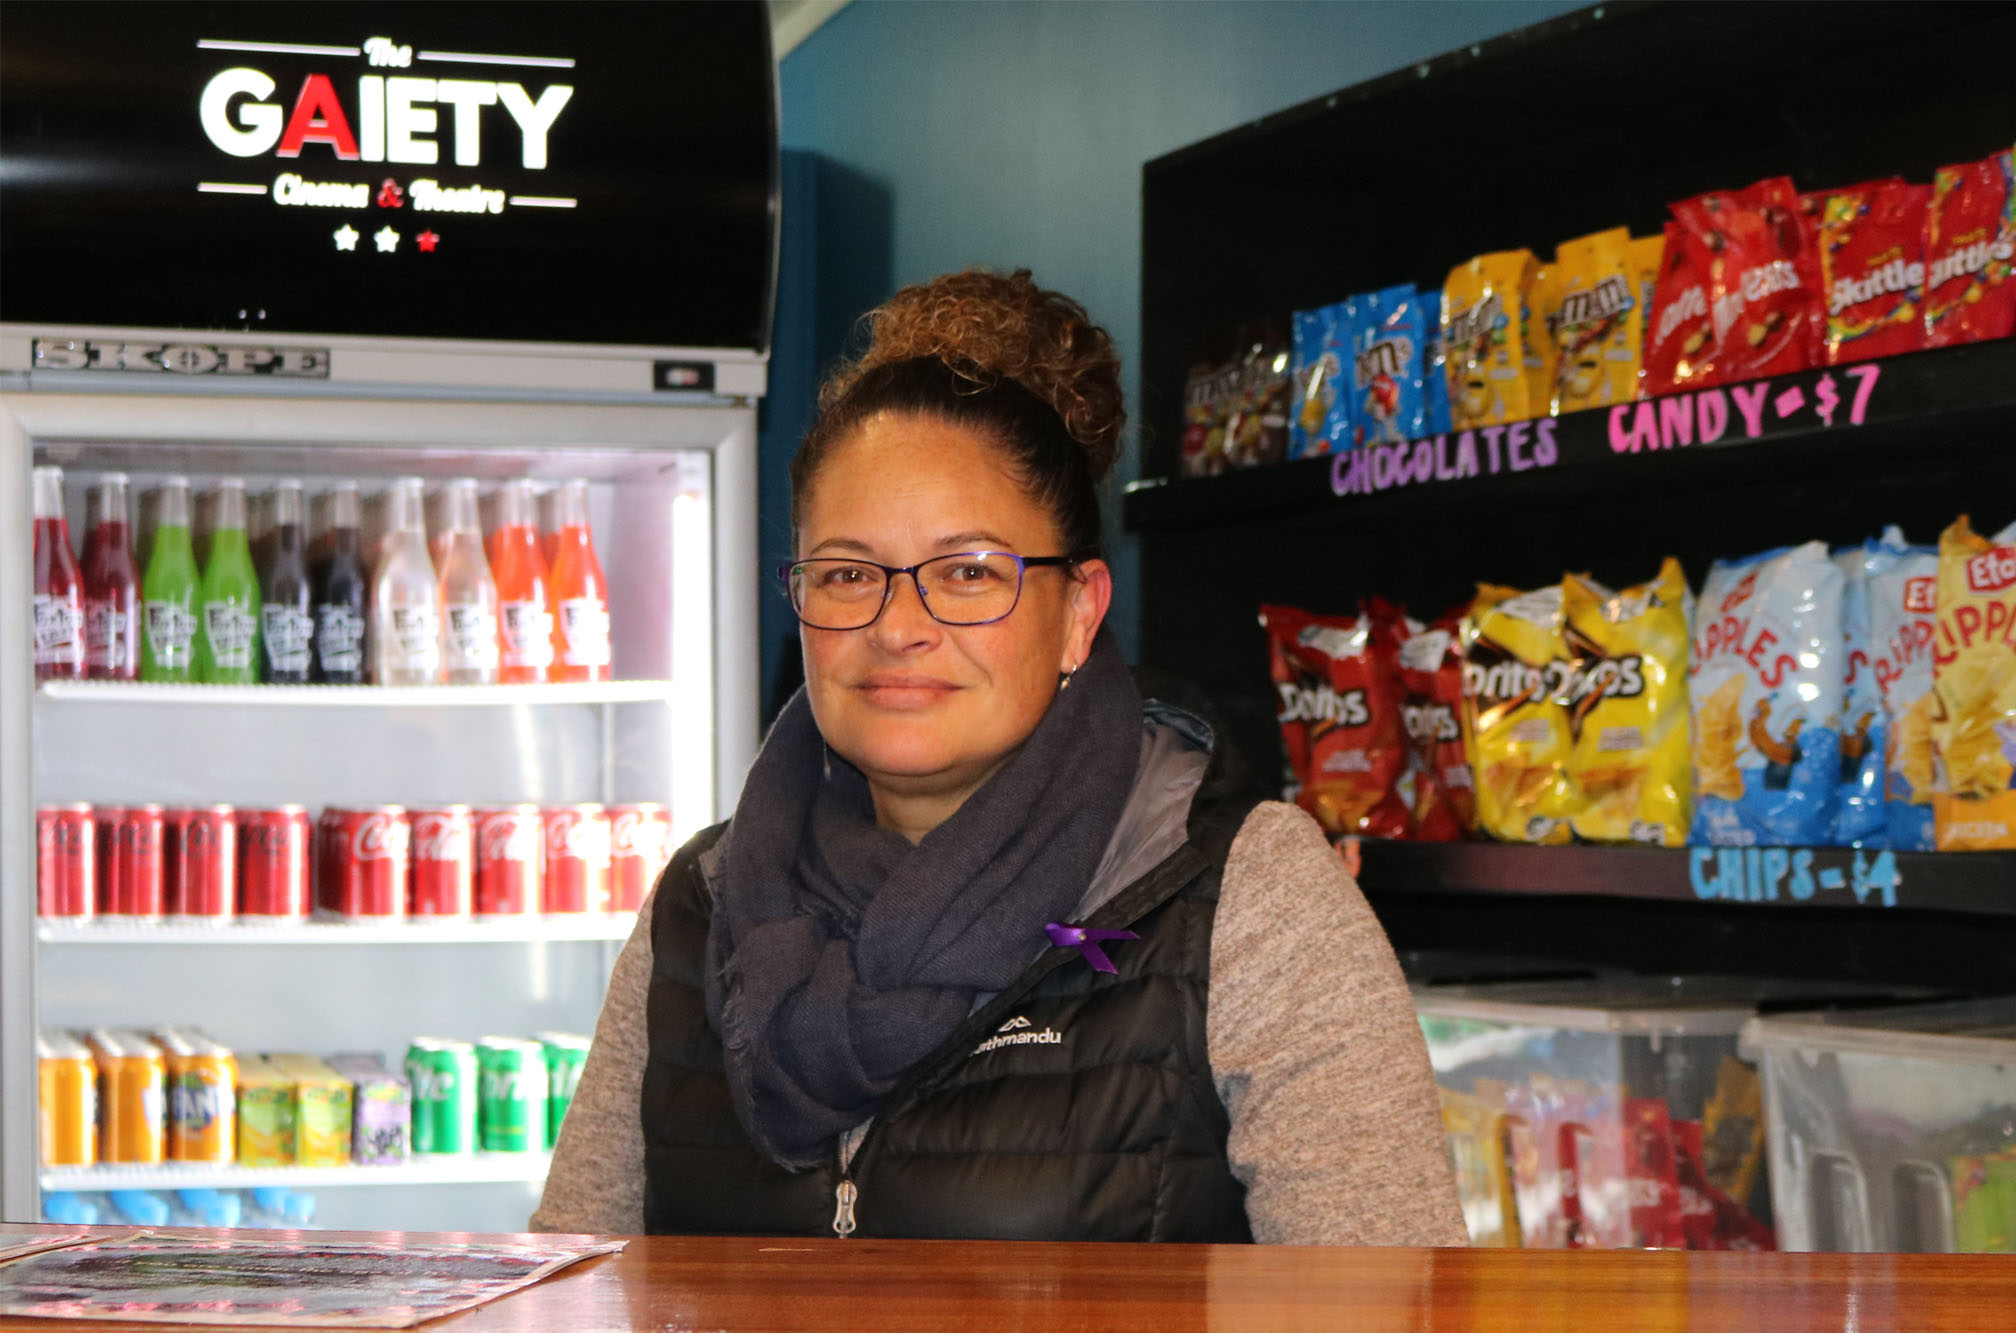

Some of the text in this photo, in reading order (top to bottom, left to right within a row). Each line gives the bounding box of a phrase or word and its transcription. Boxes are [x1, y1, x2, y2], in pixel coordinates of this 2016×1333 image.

[363, 37, 412, 68] The
[199, 68, 574, 170] GAIETY
[273, 173, 505, 214] Cinema & Theatre
[1831, 258, 1926, 315] Skittle
[33, 337, 330, 378] SKOPE
[1608, 382, 1770, 453] CANDY
[1331, 417, 1559, 497] CHOCOLATES
[1908, 581, 1937, 609] Et
[1690, 615, 1798, 688] IPPLES
[1690, 847, 1815, 901] CHIPS
[968, 1026, 1062, 1057] athmandu
